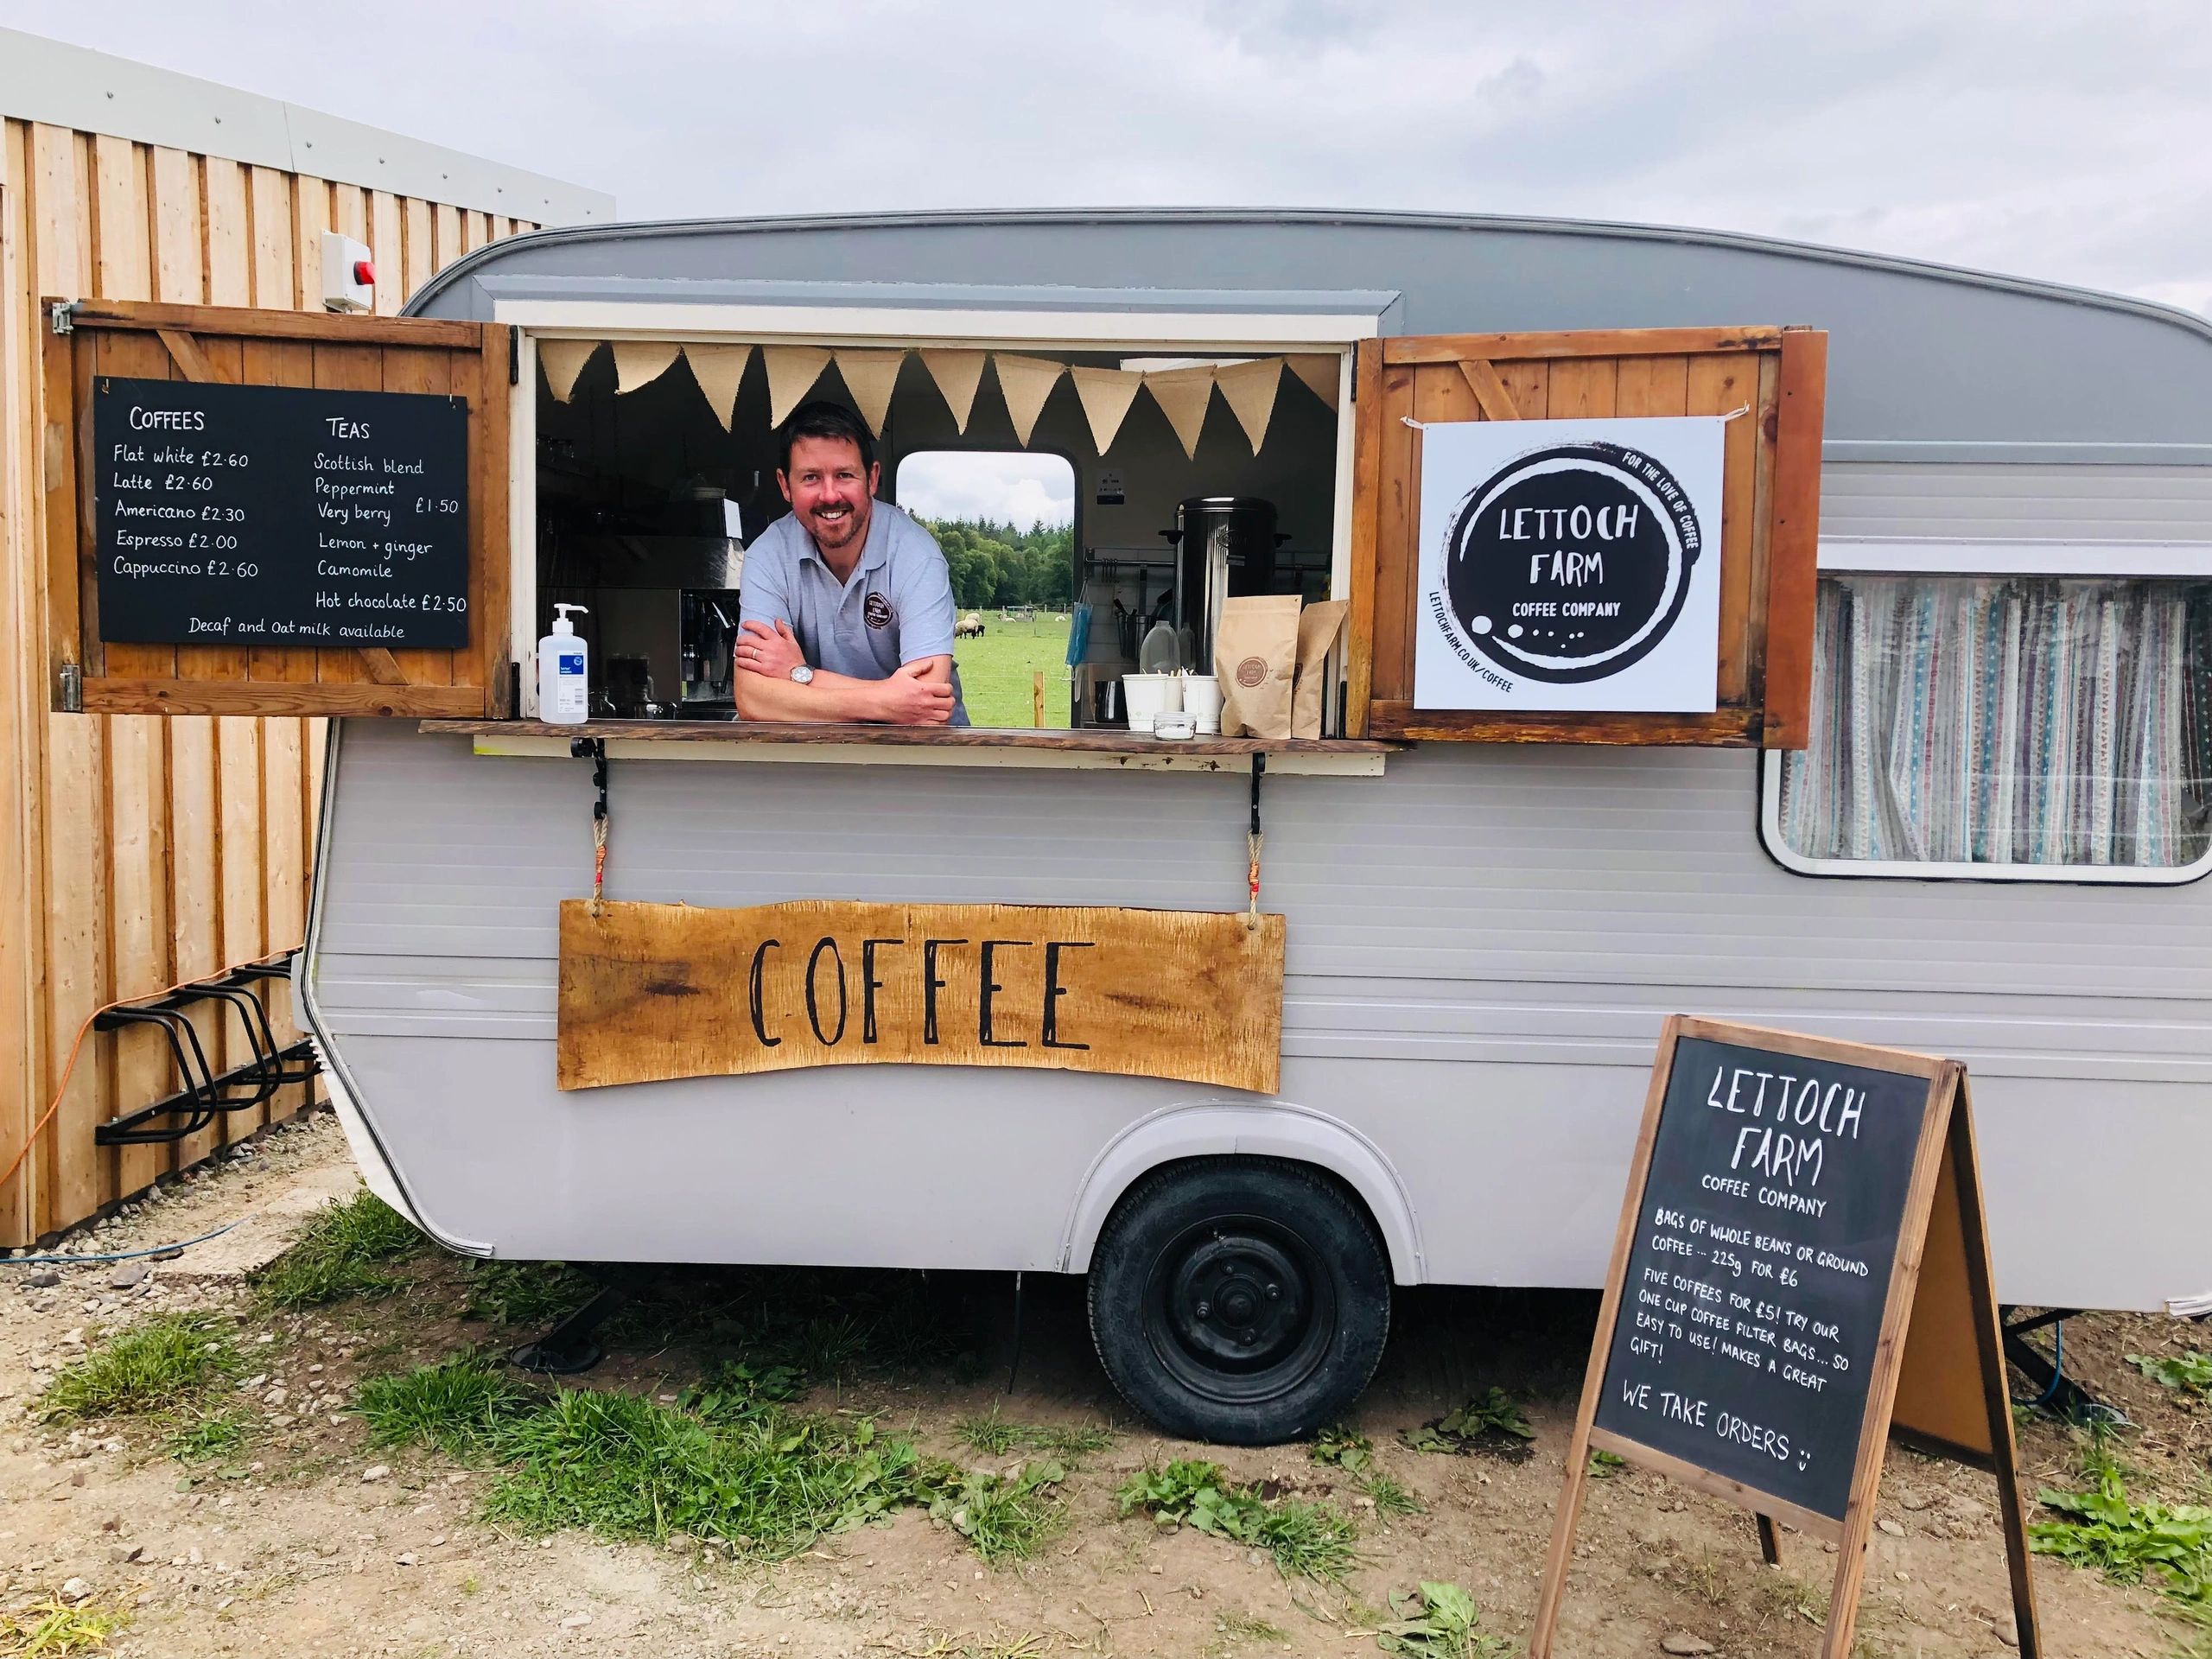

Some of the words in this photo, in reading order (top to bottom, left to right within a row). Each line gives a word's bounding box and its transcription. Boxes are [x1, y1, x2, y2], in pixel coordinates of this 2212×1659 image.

[130, 405, 205, 431] COFFEES
[325, 416, 370, 439] TEAS
[113, 443, 144, 462] Flat
[153, 445, 194, 464] white
[314, 452, 374, 471] Scottish
[383, 458, 424, 474] blend
[1622, 451, 1642, 469] FOR
[113, 472, 153, 490] Latte
[1642, 463, 1660, 481] THE
[315, 476, 395, 500] Peppermint
[1656, 477, 1679, 501] LOVE
[114, 499, 196, 519] Americano
[317, 501, 349, 525] Very
[354, 503, 391, 527] berry
[1673, 500, 1688, 512] OF
[1500, 505, 1638, 541] LETTOCH
[1680, 515, 1699, 549] COFFEE
[116, 529, 183, 550] Espresso
[319, 531, 366, 550] Lemon
[383, 542, 433, 561] ginger
[113, 555, 201, 580] Cappuccino
[317, 559, 393, 578] Camomile
[1530, 550, 1604, 587] FARM
[315, 590, 341, 608] Hot
[347, 592, 416, 609] chocolate
[1512, 602, 1556, 617] COFFEE
[1562, 601, 1621, 617] COMPANY
[188, 616, 232, 636] Decaf
[238, 618, 266, 632] and
[299, 622, 331, 636] milk
[339, 623, 405, 639] available
[749, 936, 1096, 1051] COFFEE
[1707, 1065, 1866, 1140] LETTOCH
[1730, 1127, 1823, 1187] FARM
[1701, 1173, 1751, 1198] COFFEE
[1758, 1186, 1827, 1218] COMPANY
[1654, 1206, 1686, 1230] BAGS
[1689, 1217, 1707, 1235] OF
[1710, 1224, 1751, 1246] WHOLE
[1754, 1235, 1793, 1255] BEANS
[1796, 1246, 1815, 1264] OR
[1816, 1250, 1869, 1277] GROUND
[1651, 1235, 1694, 1256] COFFEE
[1711, 1249, 1742, 1278] 225g
[1751, 1260, 1774, 1279] FOR
[1778, 1267, 1798, 1287] £6
[1643, 1267, 1669, 1286] FIVE
[1673, 1274, 1723, 1303] COFFEES
[1729, 1292, 1751, 1313] FOR
[1755, 1300, 1782, 1325] £5!
[1785, 1310, 1808, 1332] TRY
[1812, 1321, 1840, 1344] OUR
[1638, 1288, 1662, 1306] ONE
[1664, 1297, 1688, 1316] CUP
[1690, 1306, 1730, 1331] COFFEE
[1736, 1320, 1779, 1348] FILTER
[1832, 1353, 1849, 1371] SO
[1630, 1336, 1663, 1364] GIFT!
[1636, 1311, 1665, 1335] EASY
[1668, 1323, 1682, 1339] TO
[1688, 1331, 1719, 1356] USE!
[1721, 1341, 1761, 1368] MAKES
[1768, 1358, 1777, 1374] A
[1783, 1363, 1827, 1393] GREAT
[1623, 1379, 1652, 1410] WE
[1660, 1392, 1708, 1427] TAKE
[1716, 1412, 1789, 1461] ORDERS
